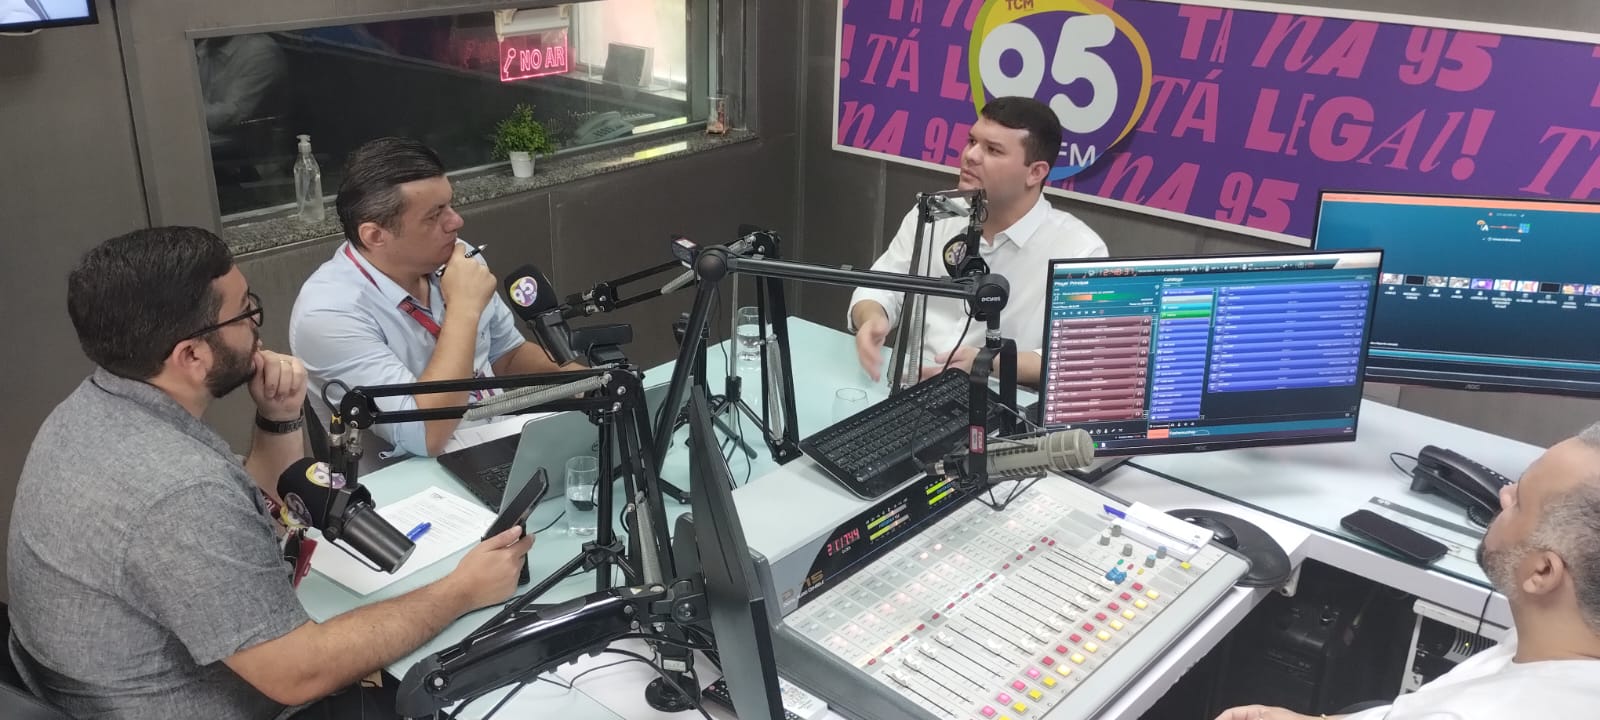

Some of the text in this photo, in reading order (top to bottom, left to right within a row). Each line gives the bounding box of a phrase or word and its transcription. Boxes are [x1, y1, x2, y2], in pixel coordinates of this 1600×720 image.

[1005, 0, 1034, 10] TCM
[520, 46, 565, 71] NO AR
[859, 28, 921, 93] TÁ
[979, 14, 1118, 134] 95
[1136, 69, 1220, 144] TÁ
[1215, 171, 1299, 233] 95
